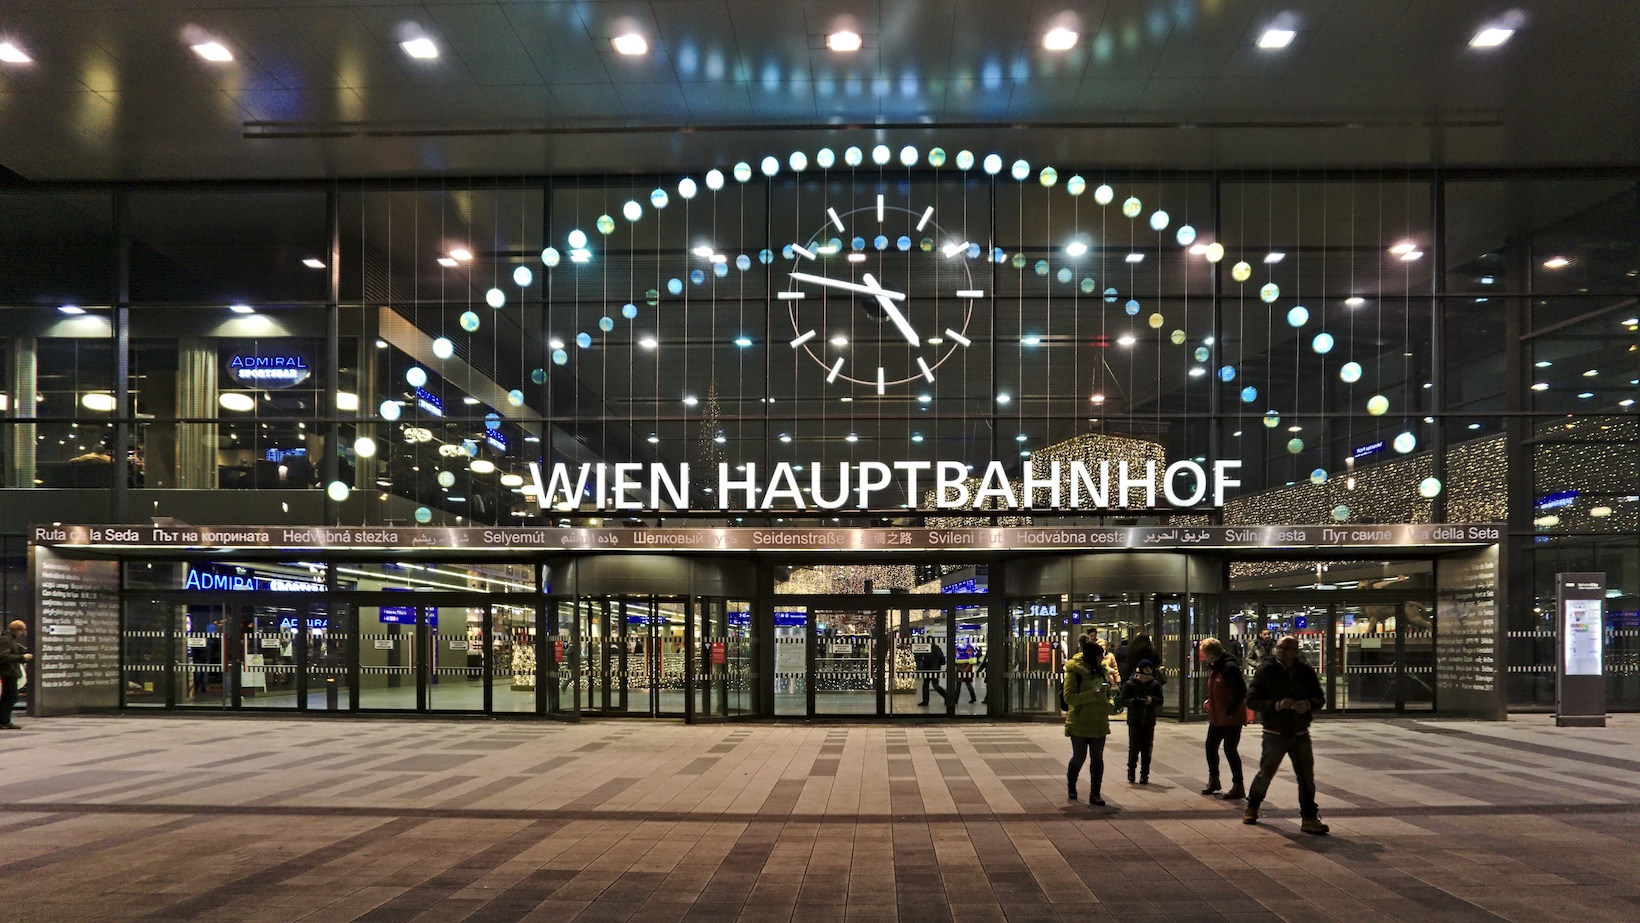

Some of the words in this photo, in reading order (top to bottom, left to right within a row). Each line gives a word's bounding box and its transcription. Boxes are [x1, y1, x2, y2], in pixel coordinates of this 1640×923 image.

[231, 355, 306, 368] ADMIRAL
[239, 368, 298, 379] SPORTSBAR
[529, 462, 689, 510] WIEN
[718, 460, 1242, 510] HAUPTBAHNHOF
[35, 528, 66, 541] Ruta
[89, 529, 101, 541] la
[105, 529, 139, 542] Seda
[152, 530, 178, 542] Път
[182, 531, 198, 542] на
[201, 532, 269, 545] коприната
[354, 530, 398, 543] stezka
[483, 530, 545, 548] Selyemút
[633, 531, 704, 544] Шелковый
[707, 533, 738, 547] уть
[752, 531, 845, 545] Seidenstraße
[928, 531, 974, 545] Svileni
[1017, 530, 1087, 544] Hodvábna
[1090, 531, 1127, 543] cesta
[1143, 529, 1178, 543] الحرير
[1180, 529, 1210, 544] طريق
[1225, 529, 1268, 542] Svilna
[1322, 529, 1348, 544] Пут
[1351, 531, 1392, 541] свиле
[1433, 527, 1465, 540] della
[1468, 527, 1499, 539] Seta
